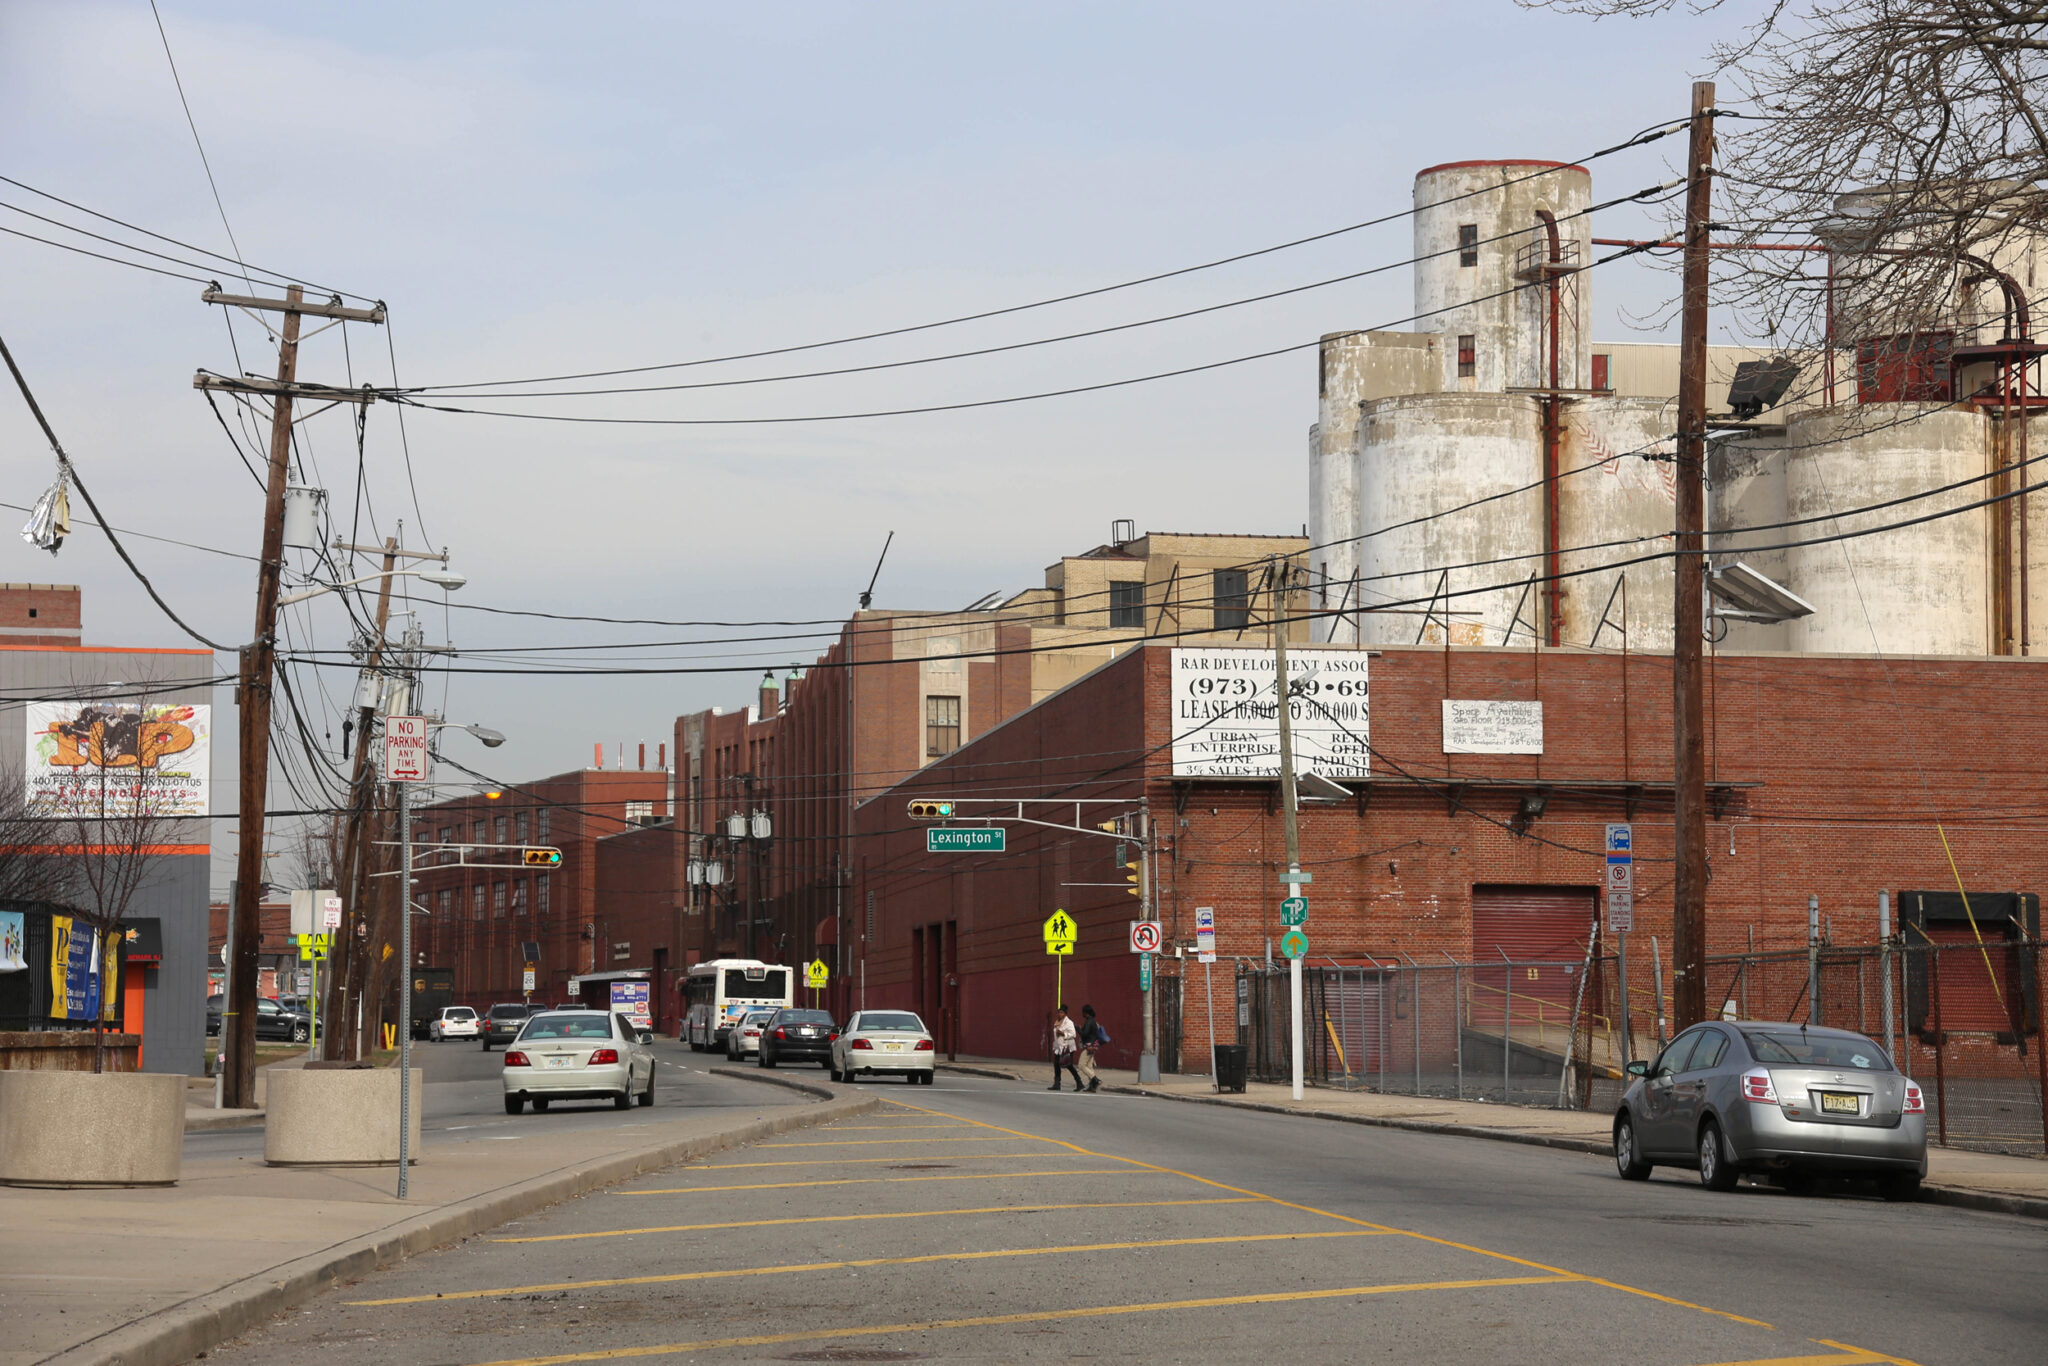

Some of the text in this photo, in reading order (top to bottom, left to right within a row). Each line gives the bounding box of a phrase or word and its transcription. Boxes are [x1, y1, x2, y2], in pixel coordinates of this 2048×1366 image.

[1181, 658, 1367, 672] RAR DEVELOPENT ASSOC
[1189, 678, 1257, 698] (973)
[1181, 700, 1229, 719] LEASE
[1306, 701, 1357, 724] 300,000
[1452, 704, 1480, 717] Space
[398, 722, 414, 734] NO
[388, 736, 424, 749] PARKING
[1210, 732, 1258, 742] URBAN
[1191, 743, 1277, 753] ENTERPRISE
[397, 759, 416, 767] TIME
[1215, 754, 1253, 764] ZONE
[1313, 756, 1368, 765] INDUST
[1186, 765, 1282, 776] 3% SALES TAX
[32, 777, 50, 785] 400
[53, 777, 87, 785] FERRY
[110, 778, 155, 786] NEWARK
[930, 831, 991, 847] Lexington
